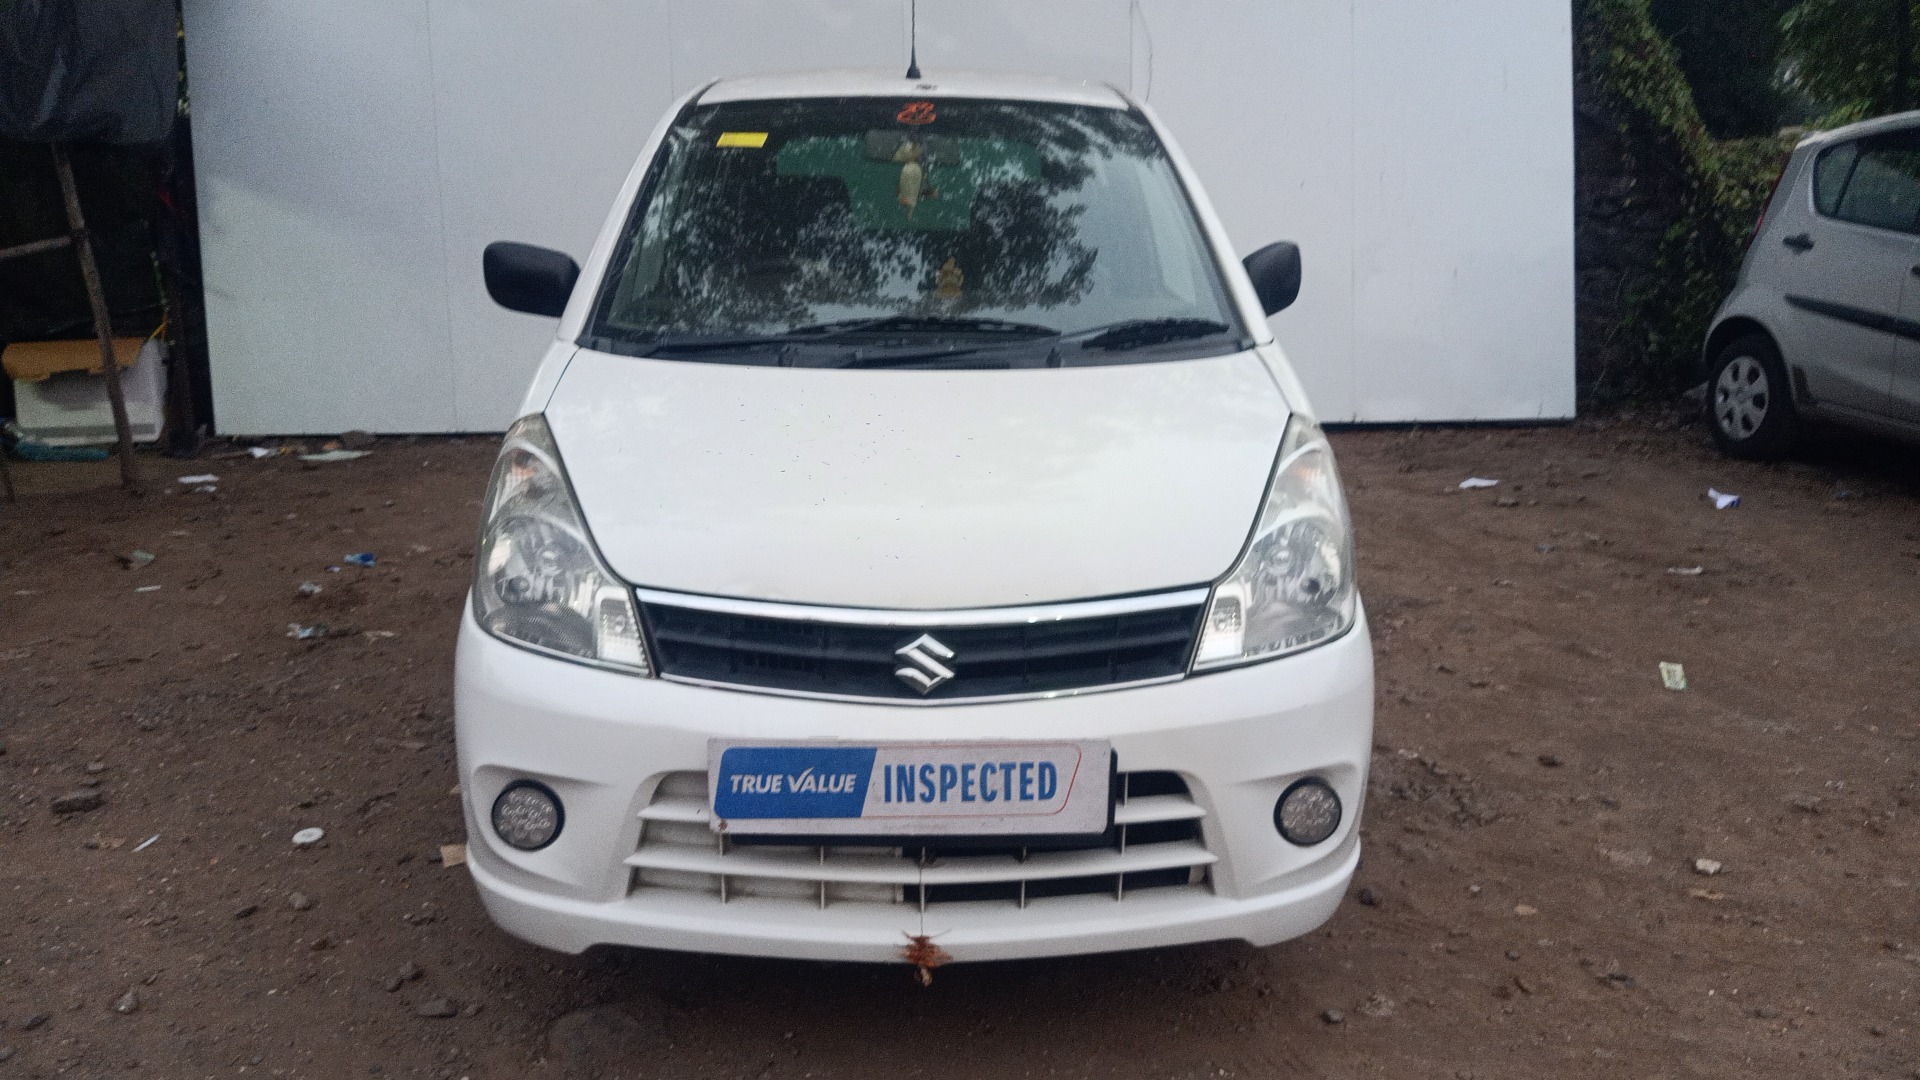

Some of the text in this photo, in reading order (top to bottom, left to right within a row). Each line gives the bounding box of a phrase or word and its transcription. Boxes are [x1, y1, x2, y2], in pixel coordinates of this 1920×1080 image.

[730, 767, 857, 794] TRUE VALUE
[883, 761, 1058, 804] INSPECTED
